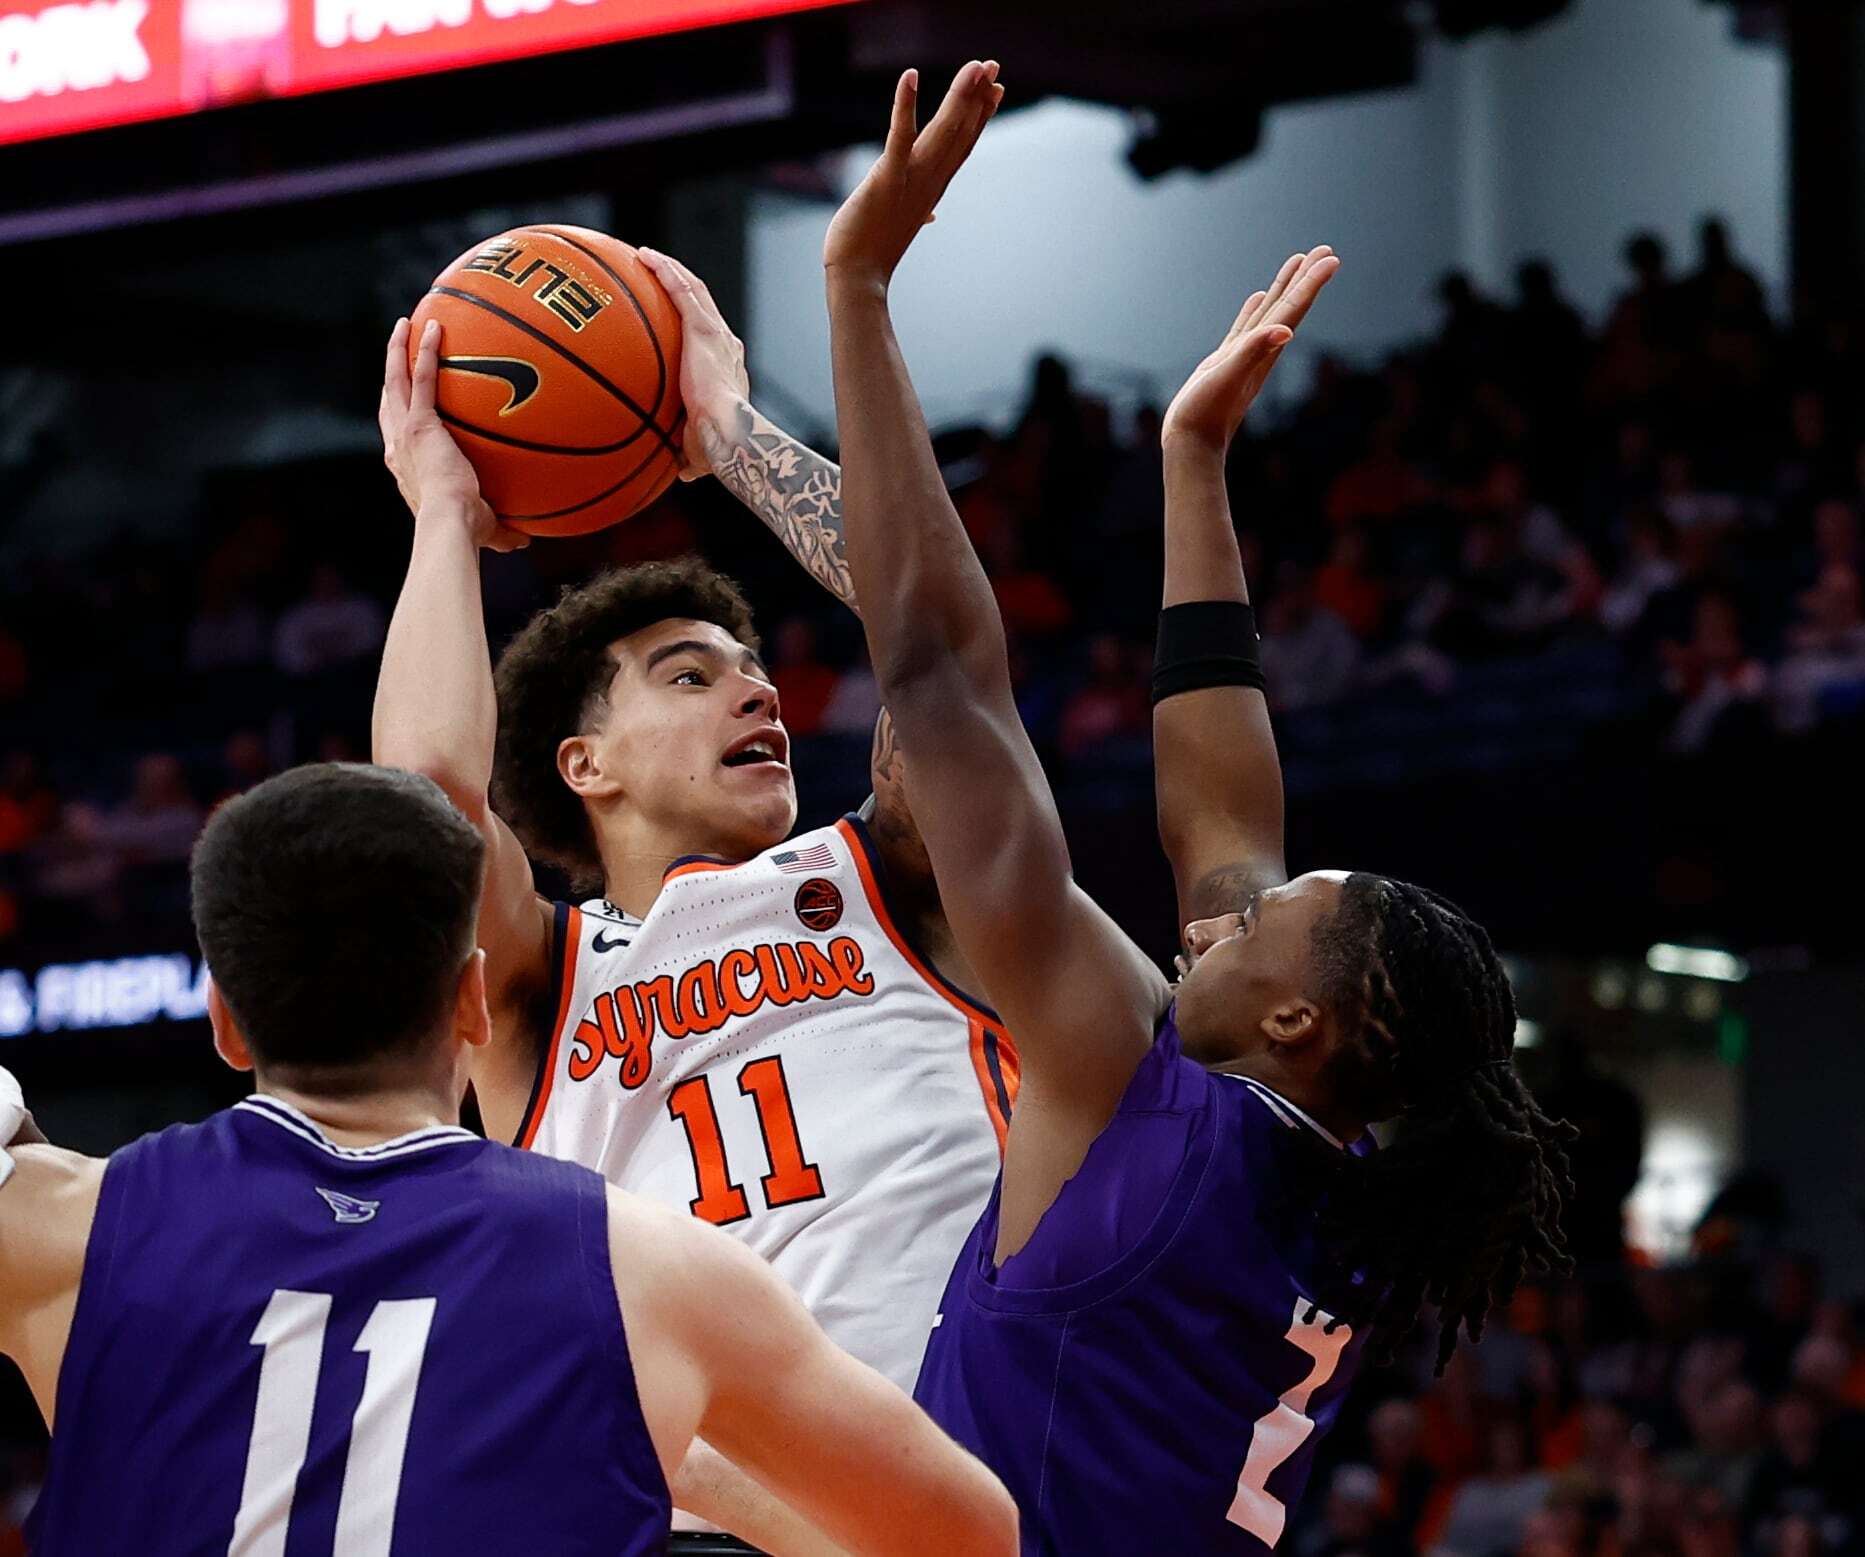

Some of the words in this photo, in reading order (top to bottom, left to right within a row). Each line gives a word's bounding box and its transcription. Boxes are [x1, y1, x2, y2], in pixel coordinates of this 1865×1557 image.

[461, 237, 604, 333] ELITE
[36, 953, 208, 1033] FIREPL
[666, 1054, 826, 1226] 11
[227, 1289, 437, 1557] 11
[1226, 1296, 1352, 1549] 2
